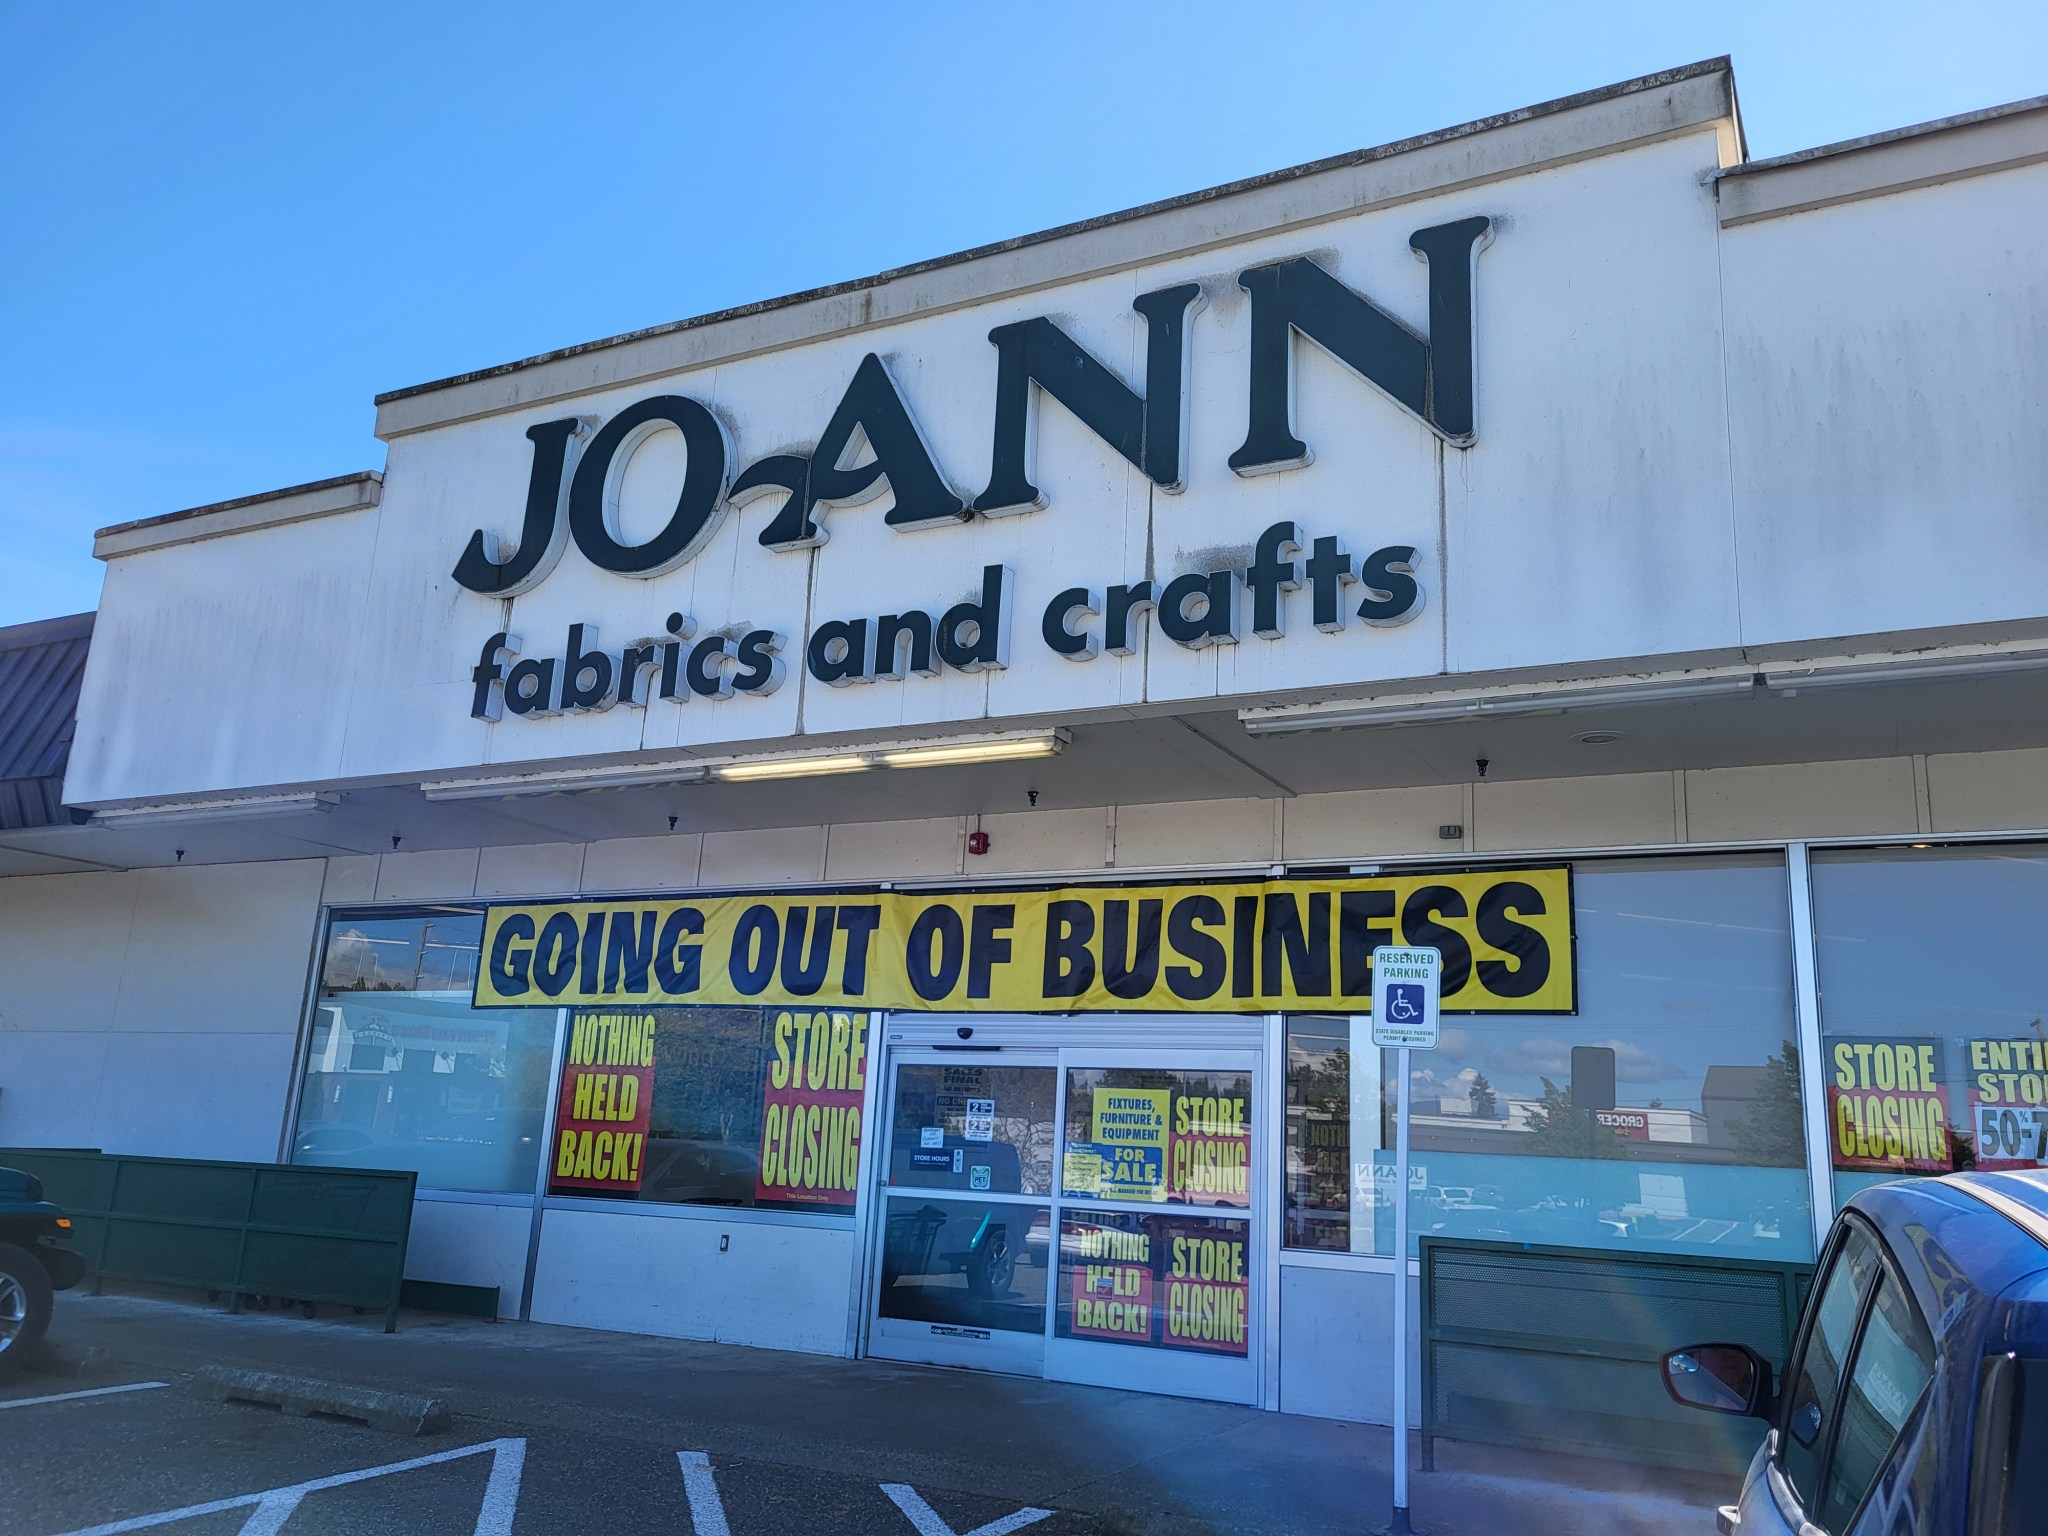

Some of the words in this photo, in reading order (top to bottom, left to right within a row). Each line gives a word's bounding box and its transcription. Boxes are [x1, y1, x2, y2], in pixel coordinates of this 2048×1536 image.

[471, 612, 785, 721] fabrics
[807, 564, 1013, 686] and
[1042, 521, 1425, 661] crafts
[490, 907, 705, 997] GOING
[728, 904, 881, 997] OUT
[906, 904, 1016, 1001] OF
[1042, 882, 1550, 1000] BUSINESS
[1379, 953, 1434, 964] RESERVED
[1383, 967, 1429, 979] PARKING
[569, 1014, 656, 1067] NOTHING
[771, 1012, 867, 1090] STORE
[1970, 1041, 2048, 1071] ENTI
[943, 1076, 982, 1084] FINAL
[1834, 1042, 1937, 1092] STORE
[572, 1073, 639, 1122] HELD
[1108, 1098, 1156, 1113] FIXTURES,
[1977, 1072, 2048, 1106] STO
[972, 1103, 979, 1112] 2
[1100, 1113, 1152, 1125] FURNITURE
[1155, 1115, 1163, 1126] &
[1175, 1096, 1244, 1137] STORE
[971, 1120, 978, 1130] 2
[1102, 1127, 1160, 1141] EQUIPMENT
[1836, 1094, 1947, 1161] CLOSING
[556, 1130, 643, 1181] BACK!
[762, 1103, 860, 1191] CLOSING
[1114, 1148, 1145, 1163] FOR
[1101, 1162, 1157, 1183] SALE
[1173, 1139, 1246, 1195] CLOSING
[1080, 1229, 1150, 1262] NOTHING
[1172, 1236, 1243, 1283] STORE
[1077, 1299, 1148, 1333] BACK!
[1169, 1281, 1245, 1344] CLOSING
